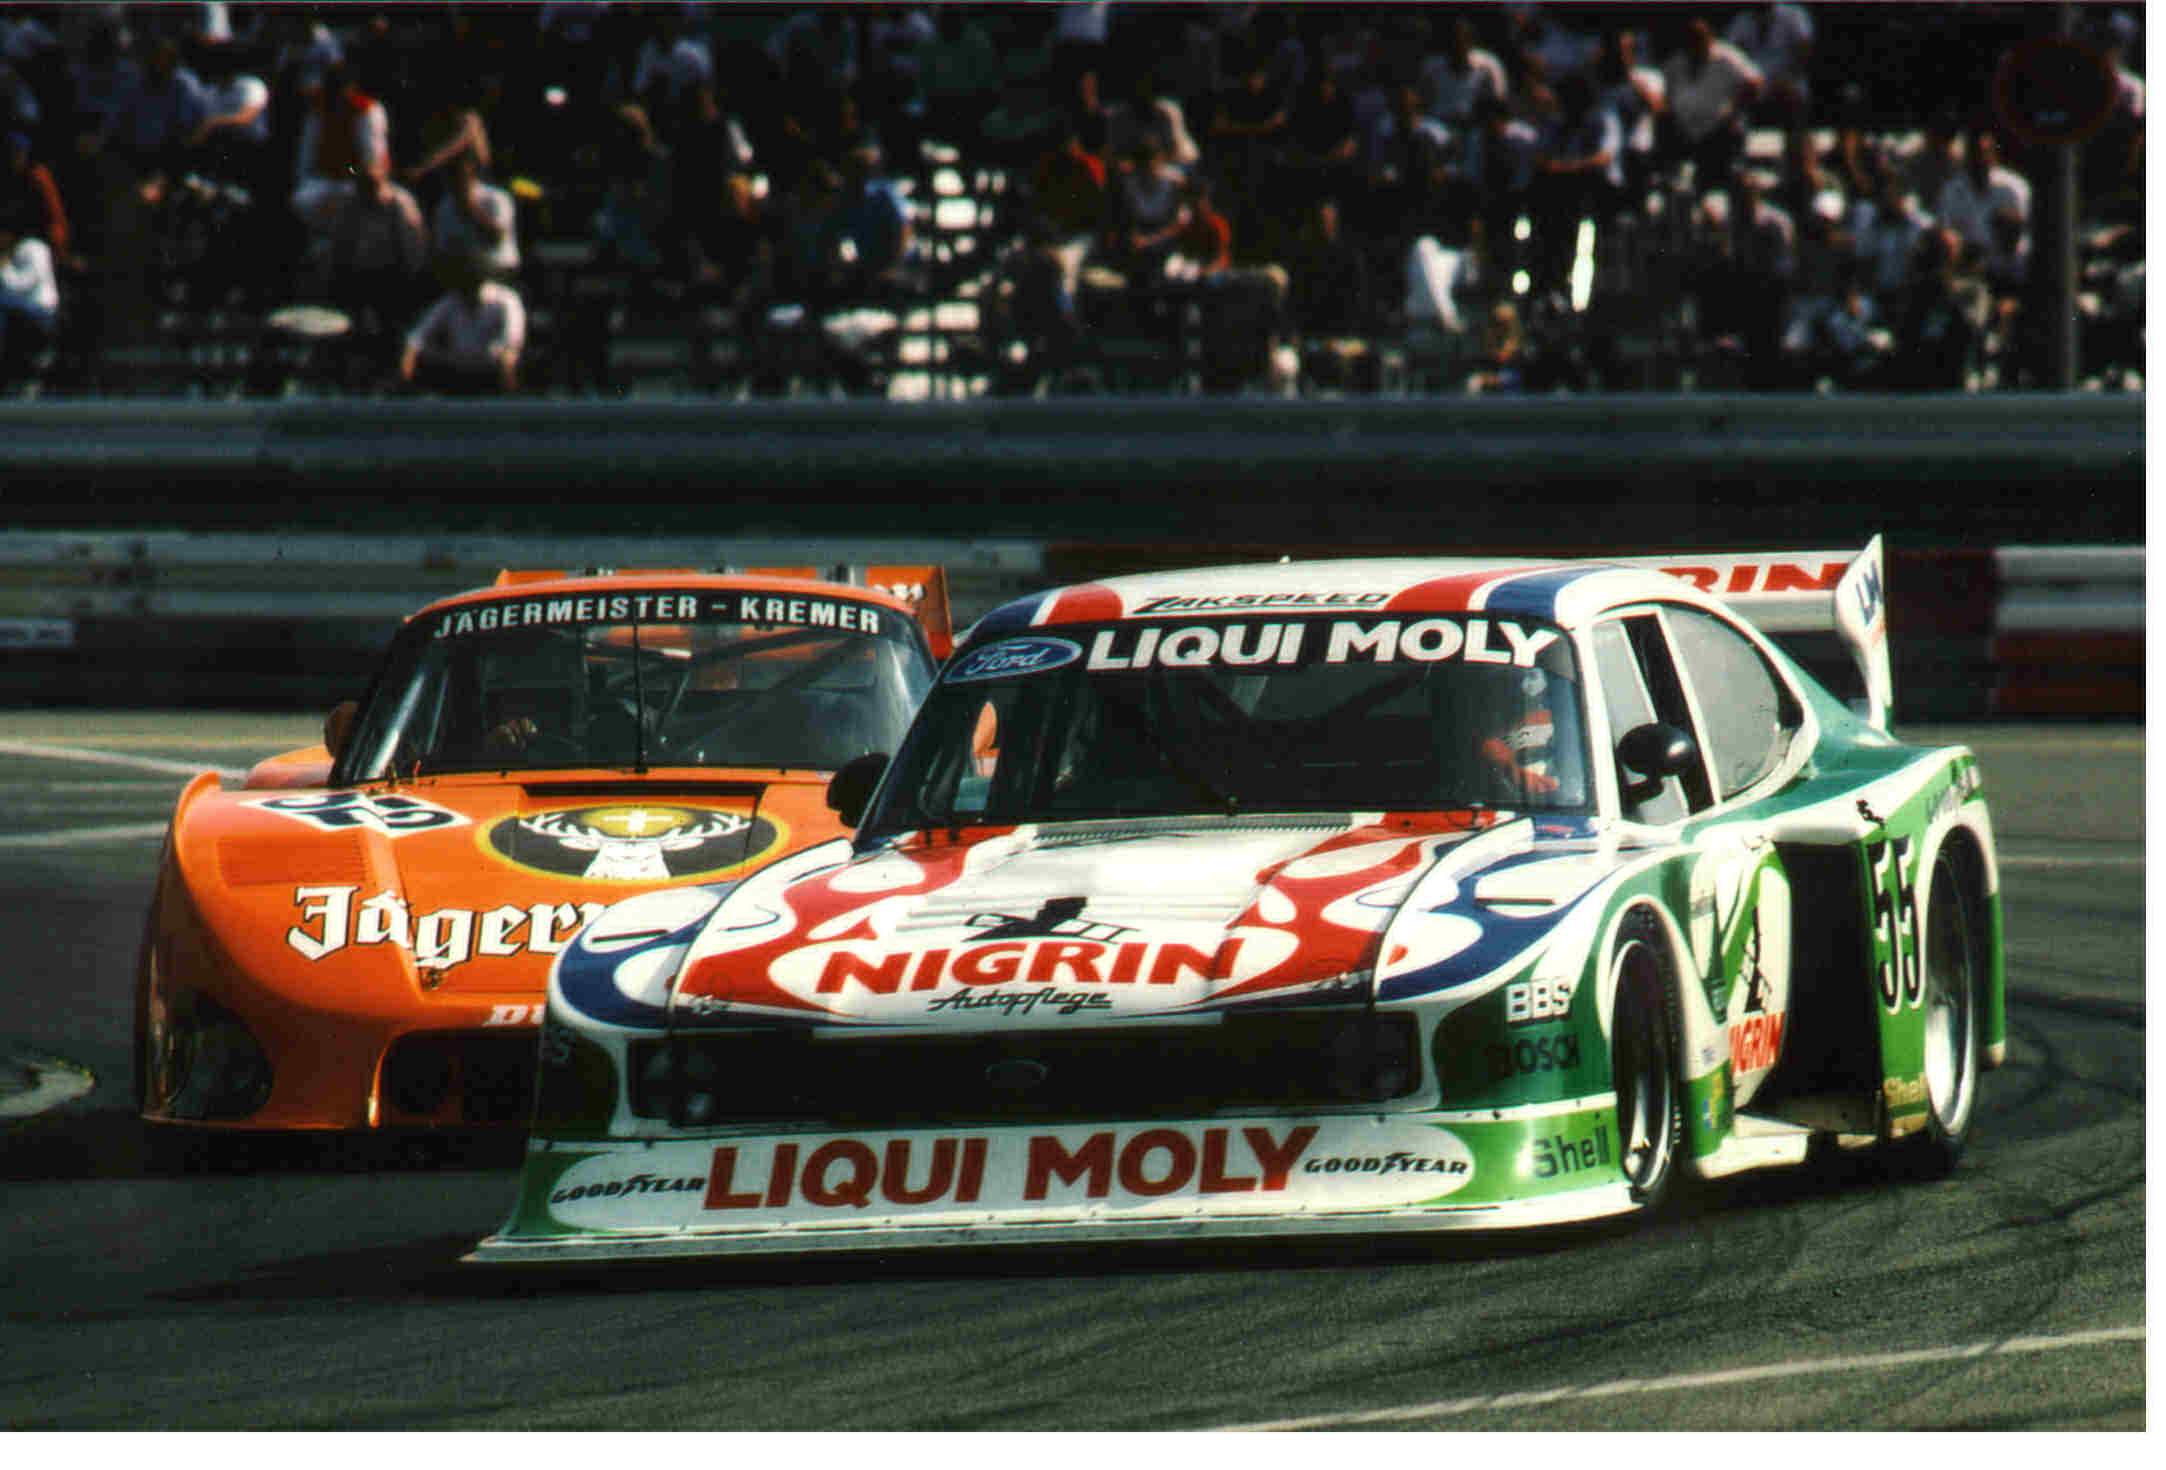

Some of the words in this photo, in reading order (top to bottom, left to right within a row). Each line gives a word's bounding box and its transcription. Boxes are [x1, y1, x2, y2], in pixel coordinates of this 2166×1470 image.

[741, 597, 880, 635] KREMER
[1133, 592, 1391, 614] ZAKSPEED
[965, 643, 1053, 676] Ford
[1086, 622, 1304, 671] LIQUI
[1326, 619, 1559, 668] MOLY
[1868, 834, 1923, 1013] 55
[816, 938, 1247, 994] NIGRIN
[927, 987, 1113, 1016] Autopflege
[1506, 977, 1571, 1022] BBS
[551, 1173, 707, 1204] GOODYEAR
[704, 1137, 989, 1210] LIQUI
[1023, 1126, 1320, 1201] MOLY
[1304, 1152, 1469, 1176] GOODYEAR
[1533, 1124, 1611, 1178] Shell
